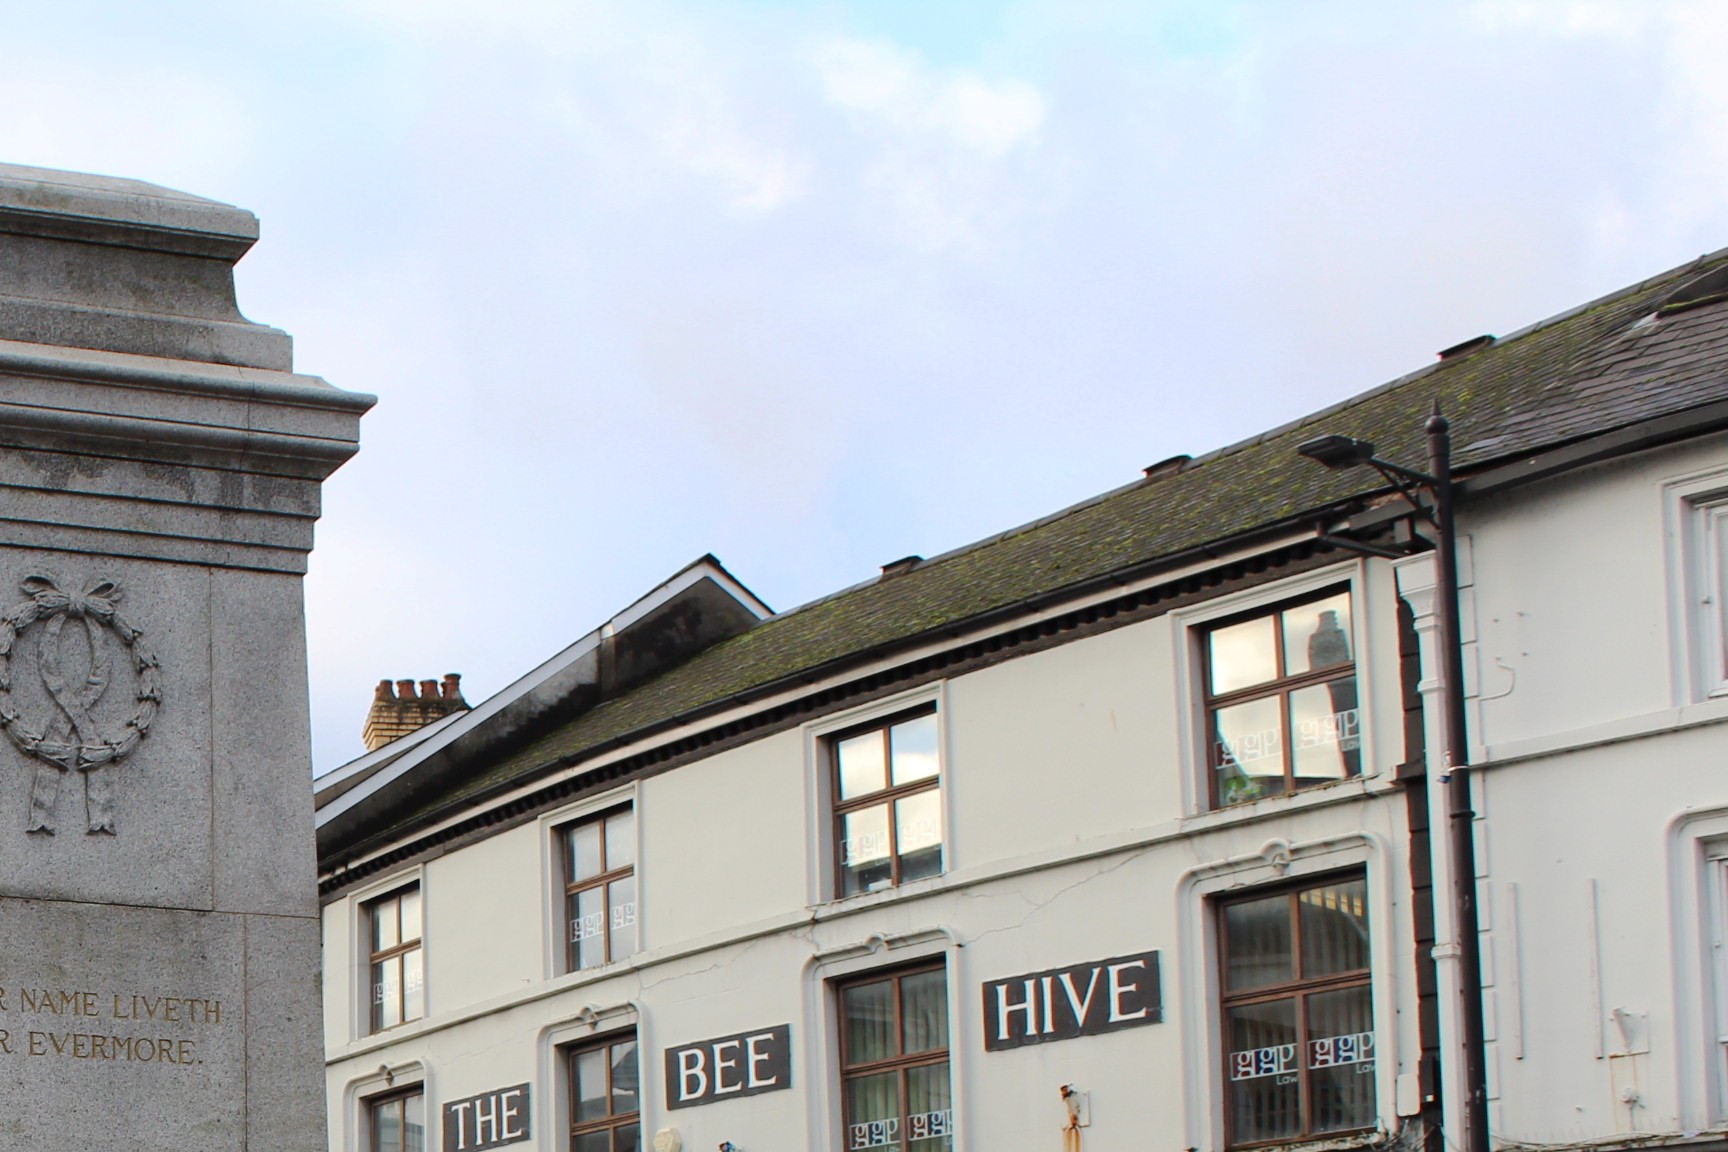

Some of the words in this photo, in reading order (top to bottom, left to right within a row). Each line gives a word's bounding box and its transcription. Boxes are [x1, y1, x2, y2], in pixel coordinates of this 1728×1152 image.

[22, 988, 100, 1017] NAME
[112, 994, 223, 1025] LIVETH
[995, 960, 1147, 1040] HIVE
[28, 1031, 203, 1065] EVERMORE.
[678, 1032, 776, 1101] BEE
[1230, 1043, 1298, 1081] ggp
[1308, 1031, 1375, 1069] ggp
[451, 1089, 522, 1150] THE
[850, 1117, 900, 1150] ggp
